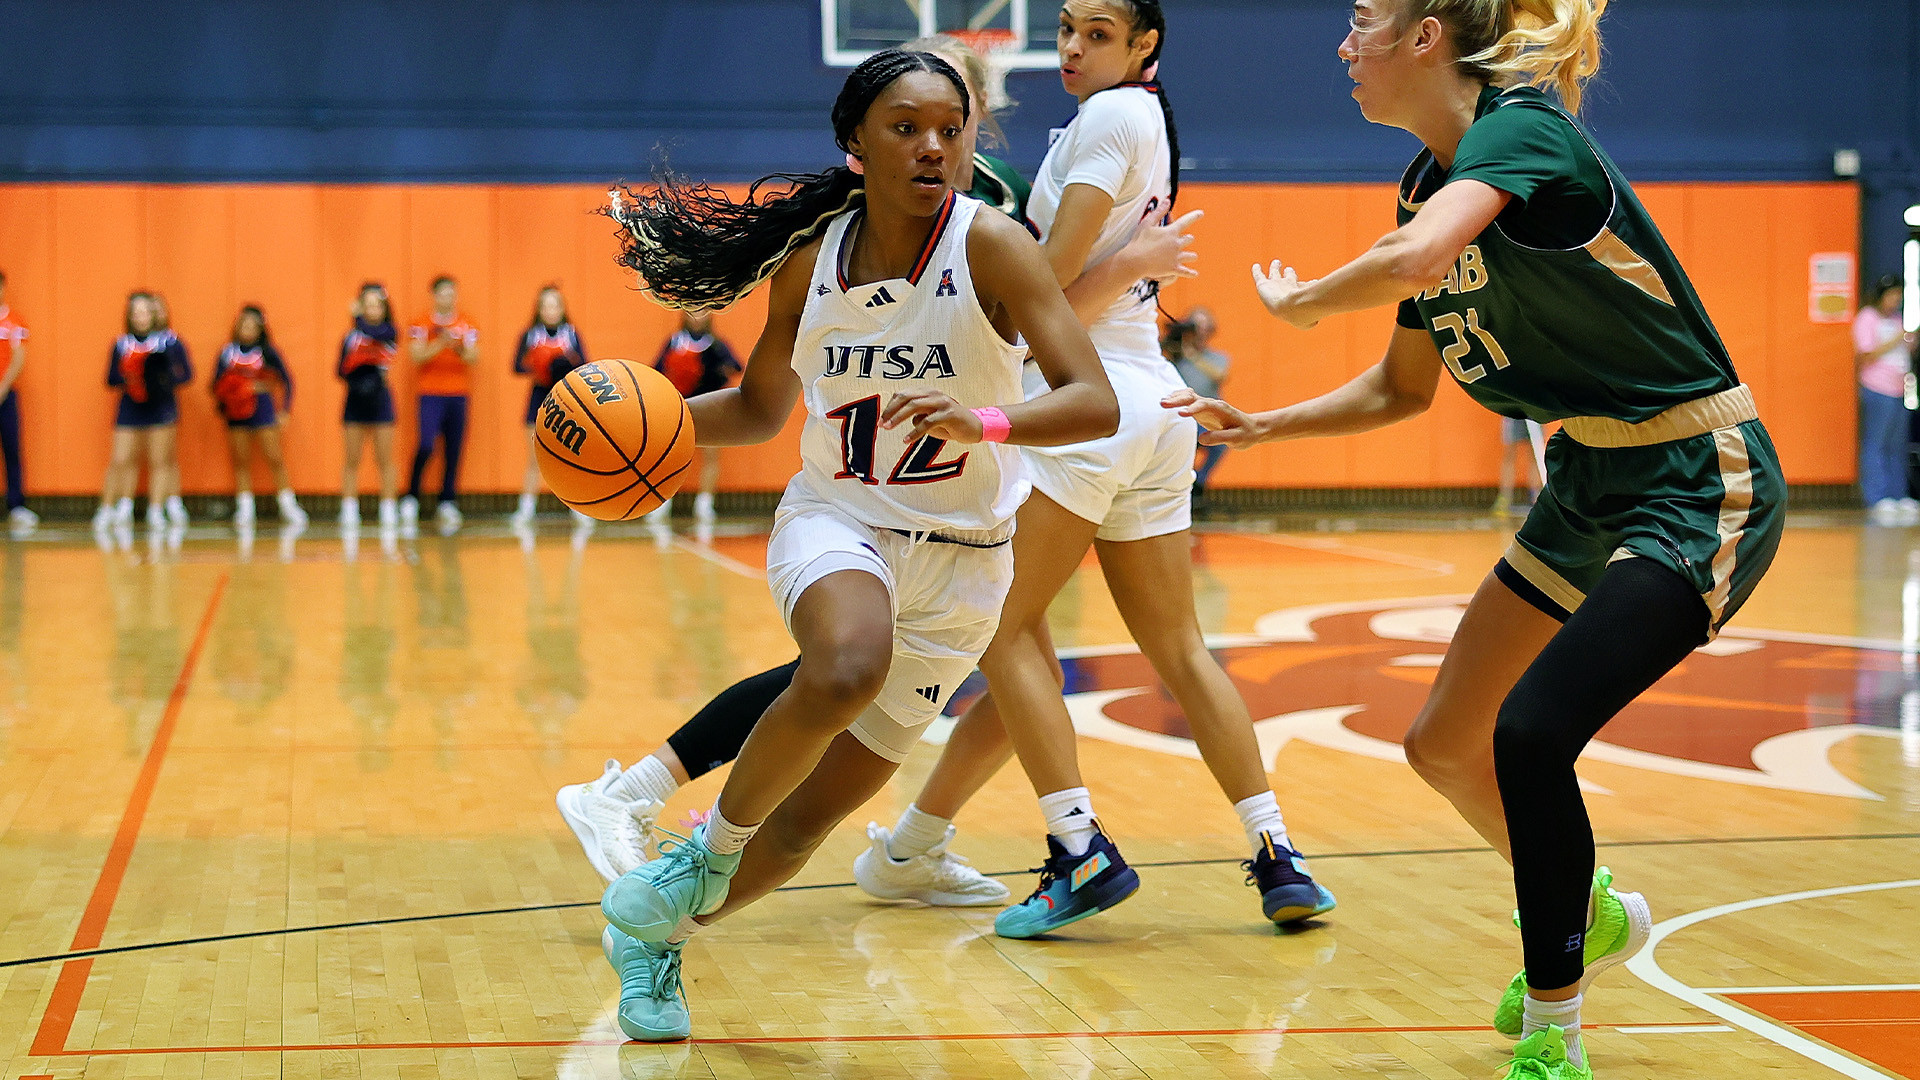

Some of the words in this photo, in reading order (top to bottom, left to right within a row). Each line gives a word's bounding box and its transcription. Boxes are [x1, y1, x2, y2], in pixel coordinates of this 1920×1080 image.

[1415, 245, 1489, 302] AB
[823, 344, 957, 379] UTSA
[1431, 308, 1511, 384] 21
